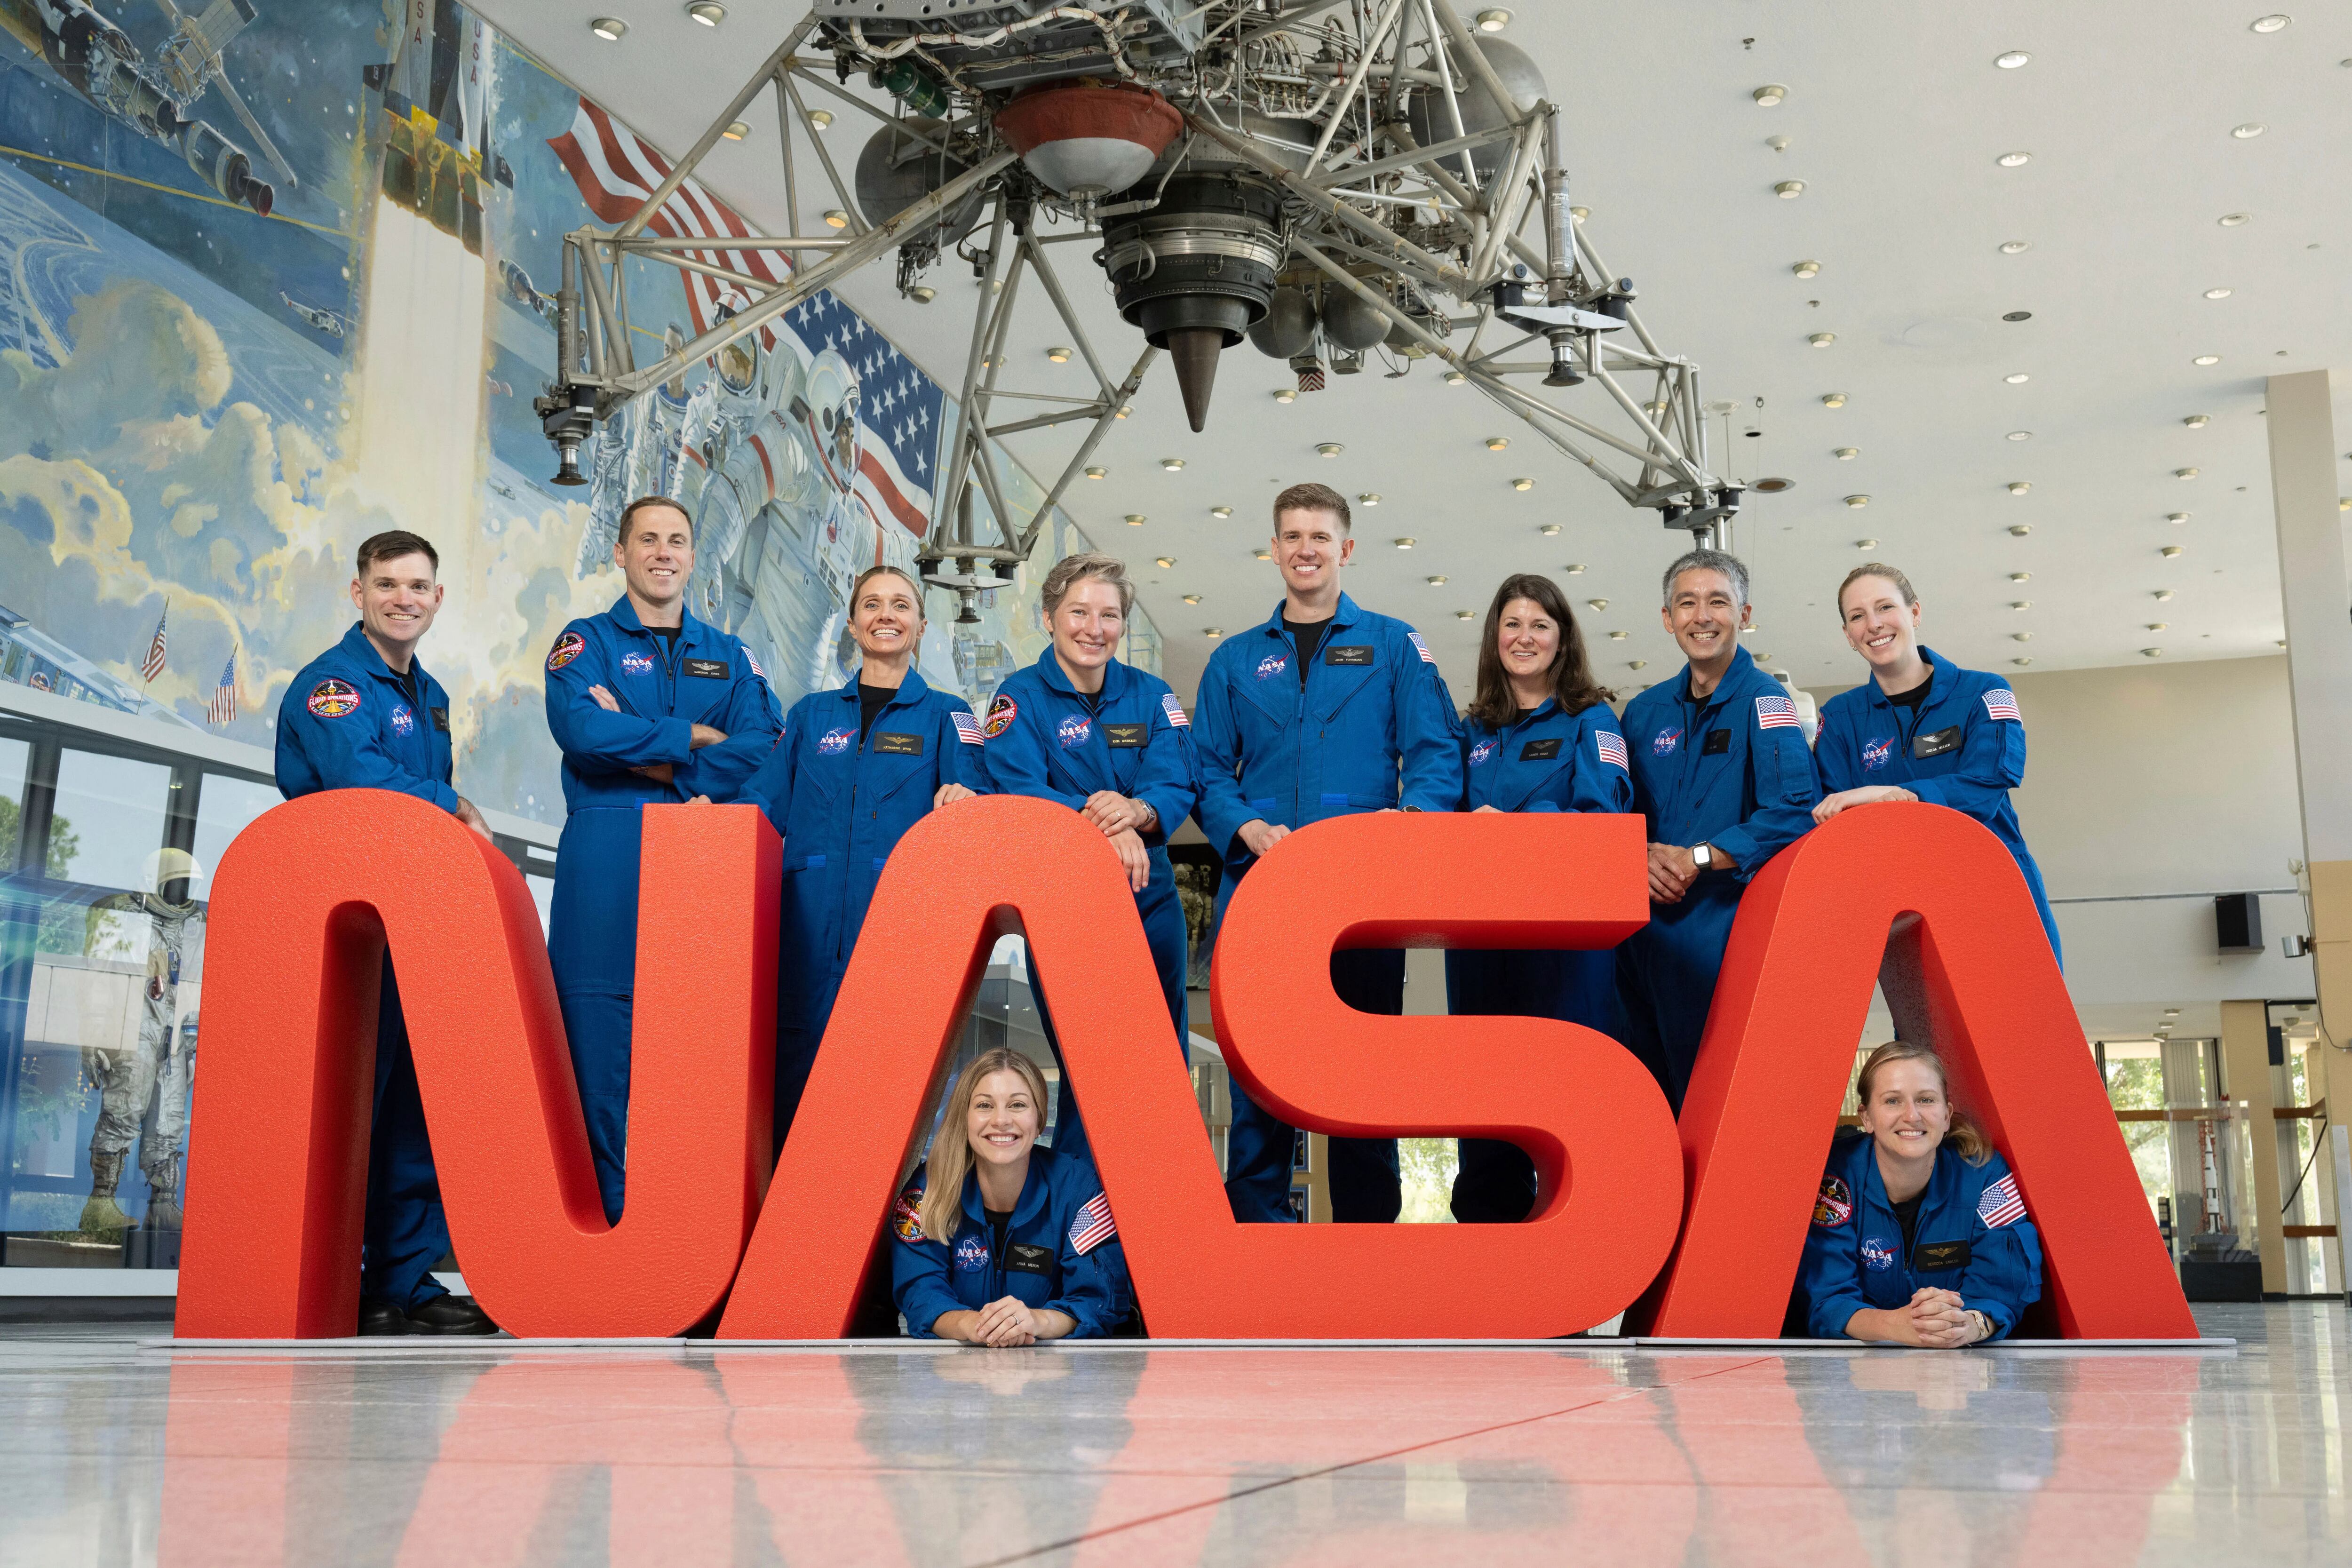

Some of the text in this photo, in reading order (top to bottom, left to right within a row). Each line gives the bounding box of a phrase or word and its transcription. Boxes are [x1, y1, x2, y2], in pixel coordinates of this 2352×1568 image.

[470, 18, 481, 86] USA
[558, 642, 583, 654] OPERATIONS
[622, 658, 653, 667] NASA
[1258, 660, 1285, 672] NASA
[309, 694, 359, 708] FLIGHT OPERATIONS
[392, 714, 413, 726] NASA
[993, 707, 1015, 720] OPERATIONS
[1059, 725, 1090, 738] NASA
[1654, 737, 1676, 746] NASA
[1469, 748, 1489, 758] NASA
[1863, 747, 1889, 760] NASA
[174, 788, 2200, 1339] NASA
[895, 1198, 921, 1224] FLIGHT OPERA
[1821, 1195, 1851, 1218] OPERATIONS
[957, 1248, 989, 1259] NASA
[1860, 1247, 1893, 1263] NASA
